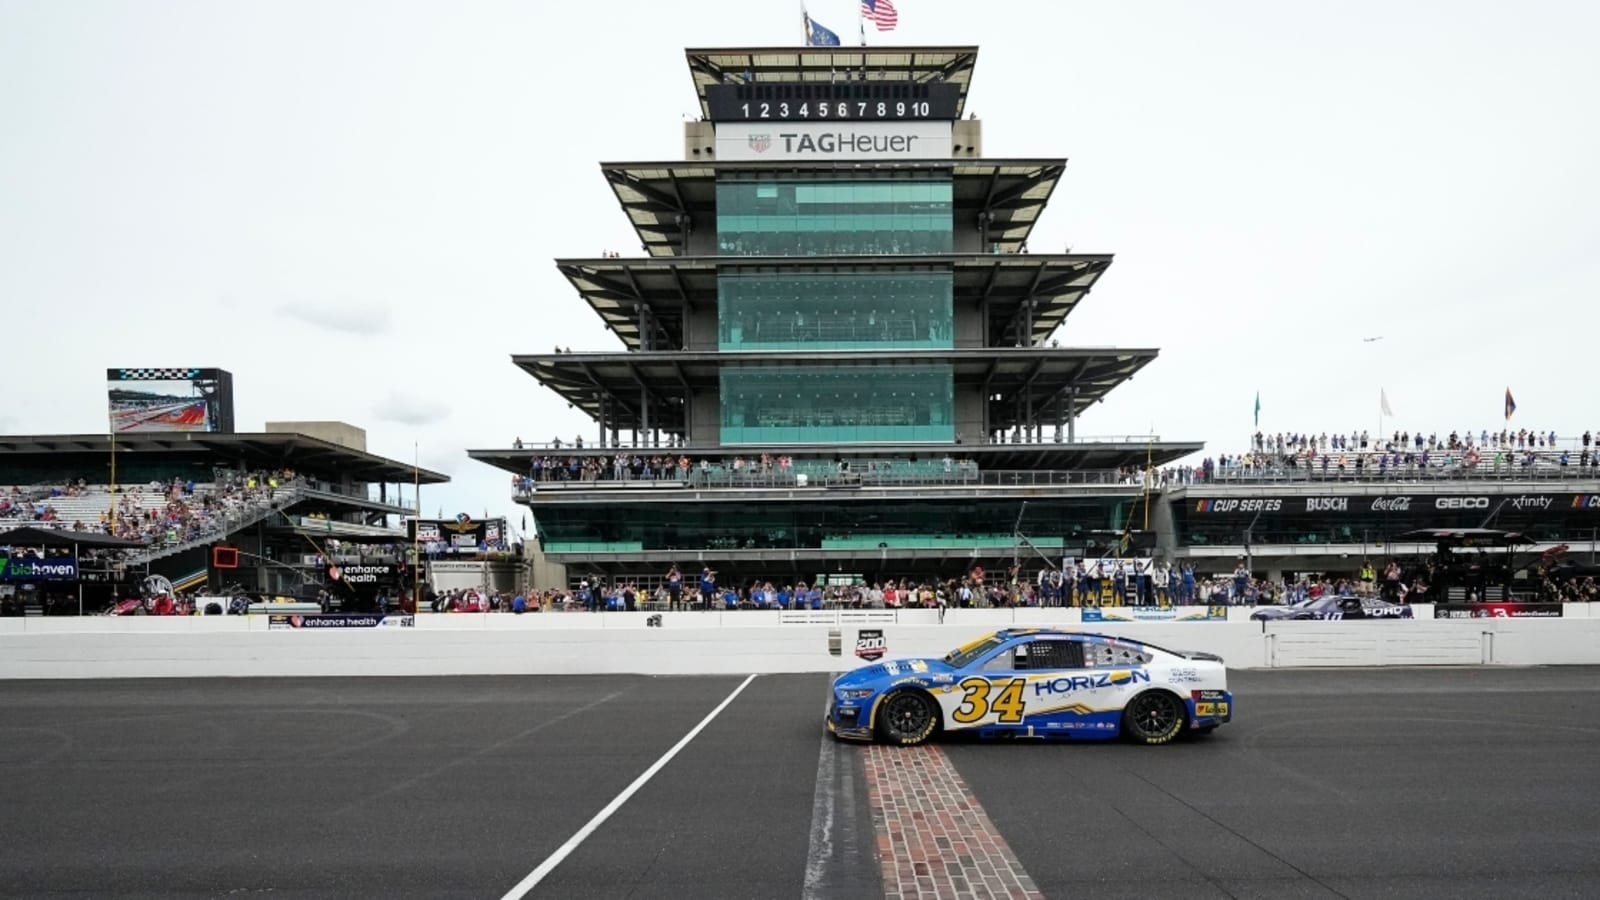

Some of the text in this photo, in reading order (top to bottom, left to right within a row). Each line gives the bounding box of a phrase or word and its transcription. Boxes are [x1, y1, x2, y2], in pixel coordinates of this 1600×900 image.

[742, 102, 930, 118] 1 2 3 4 5 6 7 8 9 10
[1213, 499, 1237, 512] CUP
[1305, 497, 1348, 512] BUSCH
[1435, 496, 1490, 509] GEICO
[1512, 495, 1553, 510] xfinity
[11, 562, 74, 575] biohaven
[344, 565, 390, 574] enhance
[344, 574, 377, 583] health
[1209, 606, 1226, 617] 34
[305, 616, 377, 626] enhance health
[857, 637, 886, 650] 200
[1035, 670, 1150, 696] HORIZON
[952, 677, 1026, 724] 34
